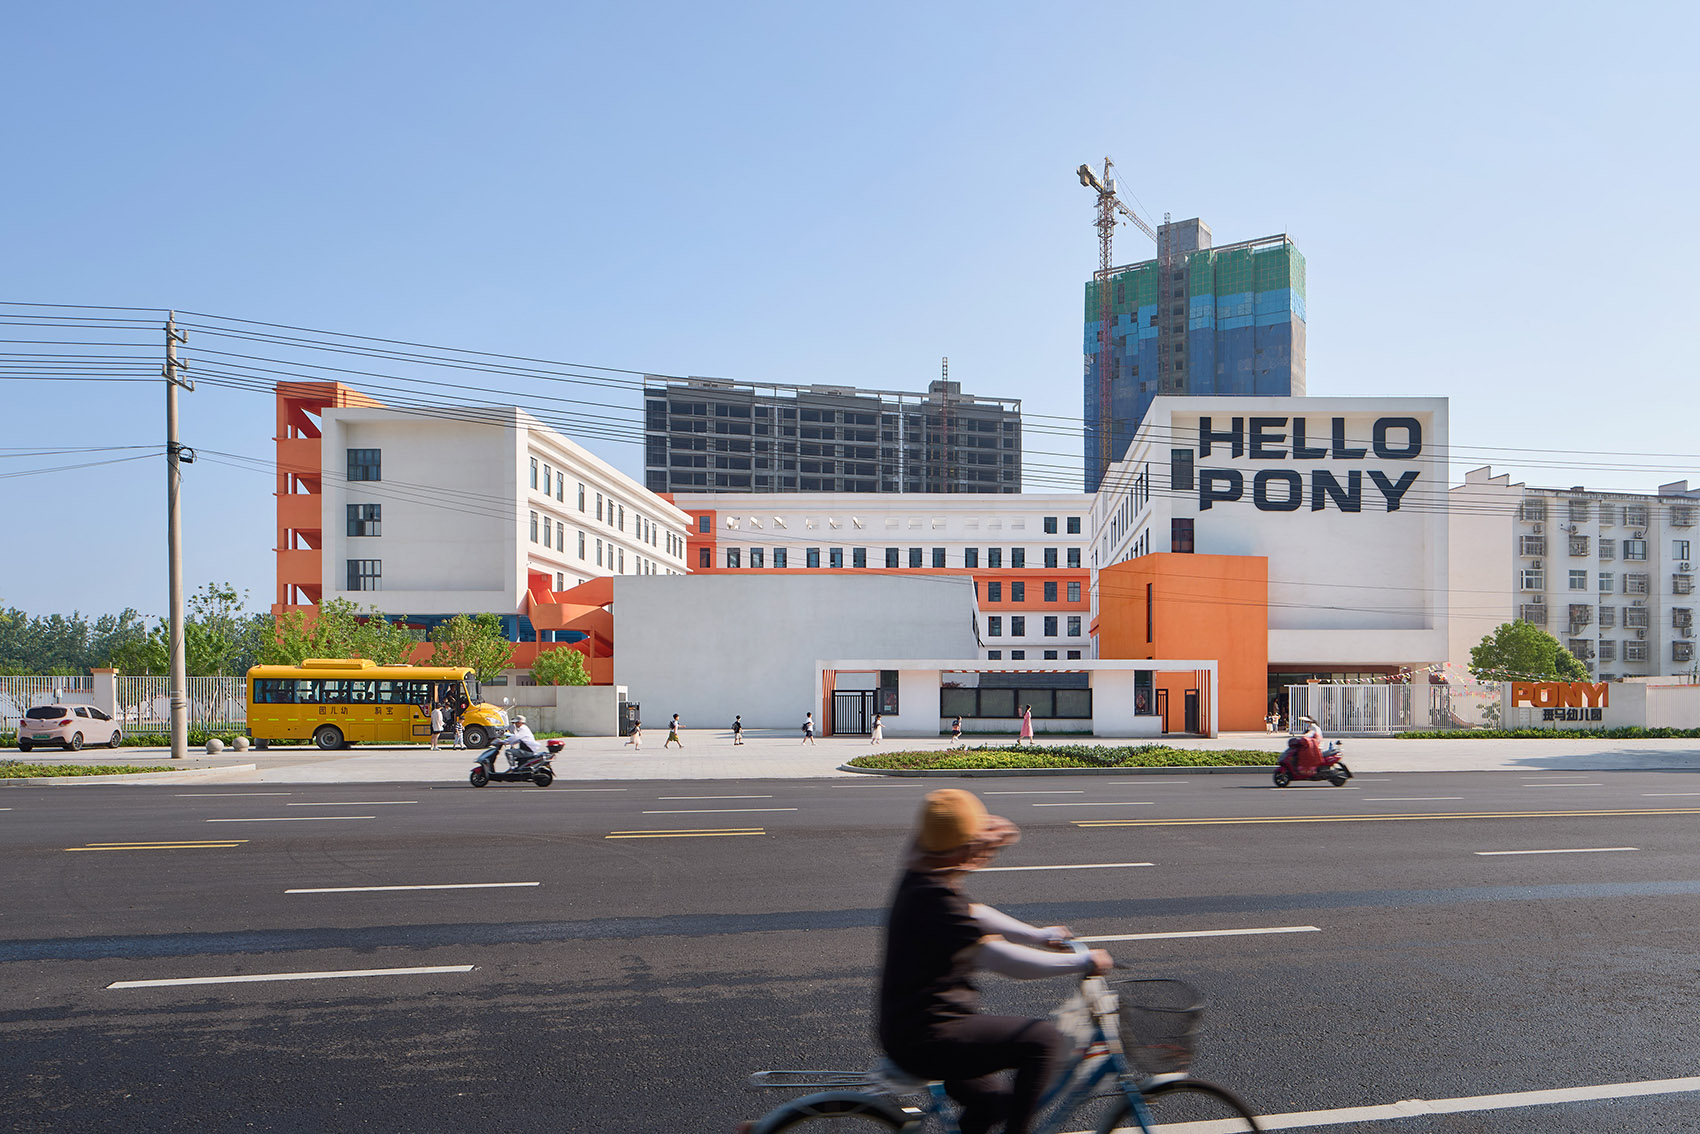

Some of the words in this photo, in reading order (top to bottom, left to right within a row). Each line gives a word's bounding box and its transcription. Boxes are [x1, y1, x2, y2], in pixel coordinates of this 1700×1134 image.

[1199, 416, 1422, 460] HELLO
[1199, 468, 1421, 513] PONY
[1511, 681, 1609, 708] PONY
[1542, 708, 1603, 722] 斑马幼儿园
